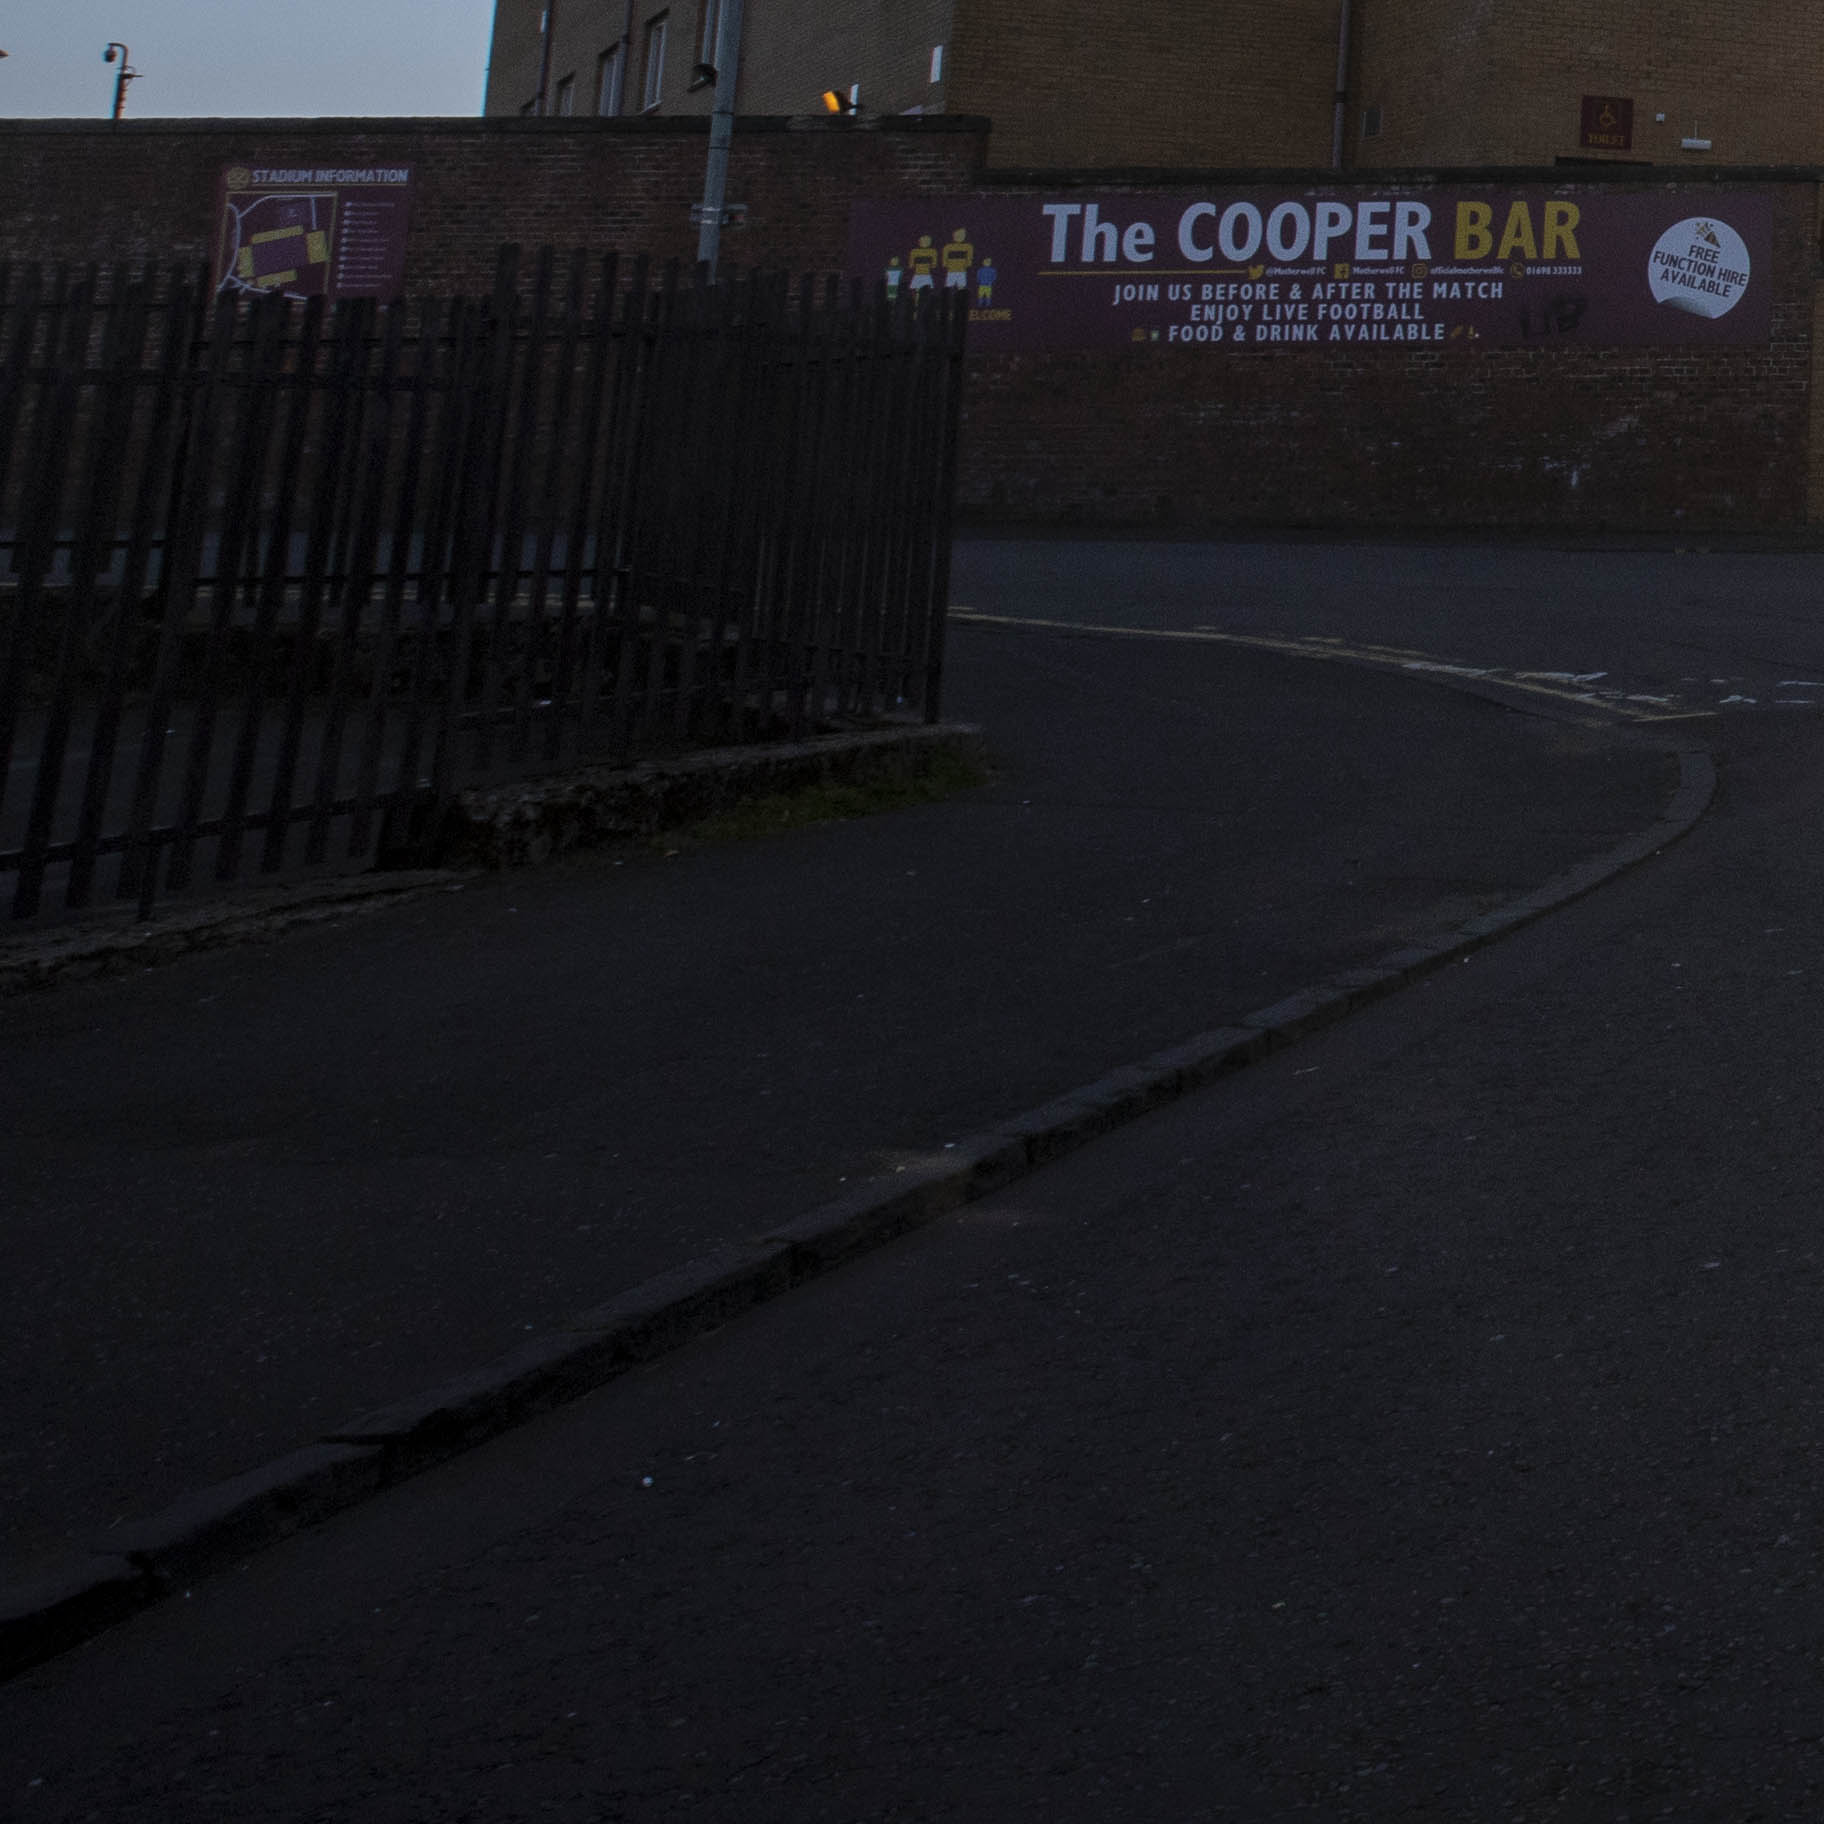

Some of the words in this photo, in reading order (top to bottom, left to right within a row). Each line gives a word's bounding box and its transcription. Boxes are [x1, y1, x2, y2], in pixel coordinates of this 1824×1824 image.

[252, 169, 313, 184] STADIUM
[314, 169, 409, 183] INFORMATION
[1042, 203, 1156, 263] The
[1177, 201, 1432, 262] COOPER
[1453, 201, 1581, 260] BAR
[1688, 244, 1721, 264] FREE
[1653, 250, 1716, 278] FUNCTION
[1717, 269, 1748, 288] HIRE
[1113, 284, 1160, 306] JOIN
[1168, 283, 1193, 301] US
[1200, 283, 1280, 301] BEFORE
[1289, 283, 1302, 300] &
[1312, 282, 1376, 300] AFTER
[1385, 282, 1423, 299] THE
[1432, 282, 1503, 299] MATCH
[1661, 268, 1732, 298] AVAILABLE
[966, 309, 1013, 321] ELCOME
[1190, 304, 1254, 325] ENJOY
[1262, 304, 1308, 321] LIVE
[1317, 303, 1425, 320] FOOTBALL
[1168, 325, 1223, 343] FOOD
[1233, 325, 1246, 342] &
[1255, 325, 1318, 342] DRINK
[1329, 324, 1445, 341] AVAILABLE
